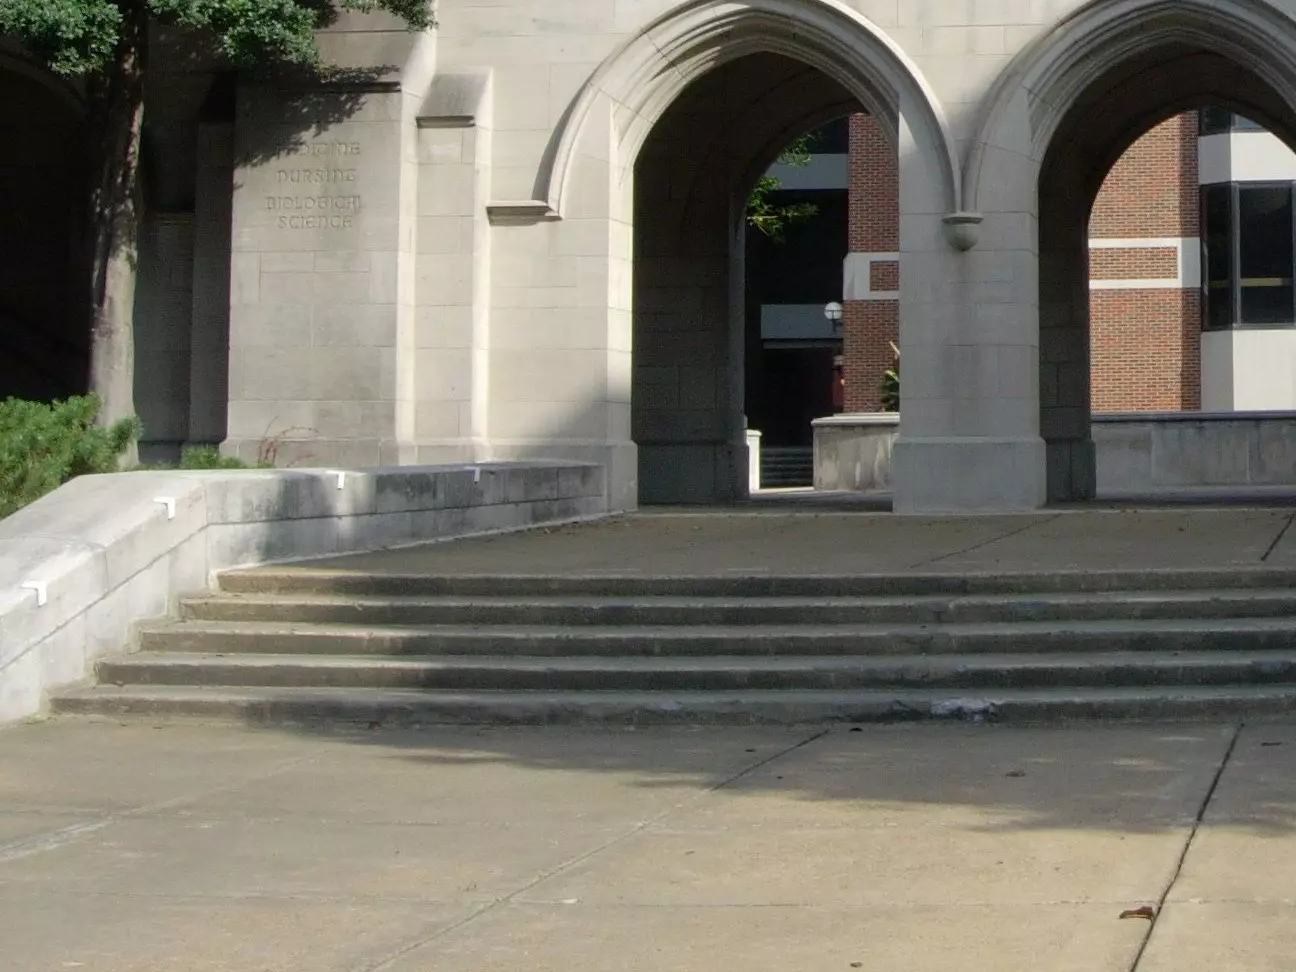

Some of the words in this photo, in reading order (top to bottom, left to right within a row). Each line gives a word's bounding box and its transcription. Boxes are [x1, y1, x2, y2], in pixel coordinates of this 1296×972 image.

[277, 142, 361, 156] DICINE
[278, 170, 356, 183] NURSING
[278, 216, 353, 228] SCIENCE
